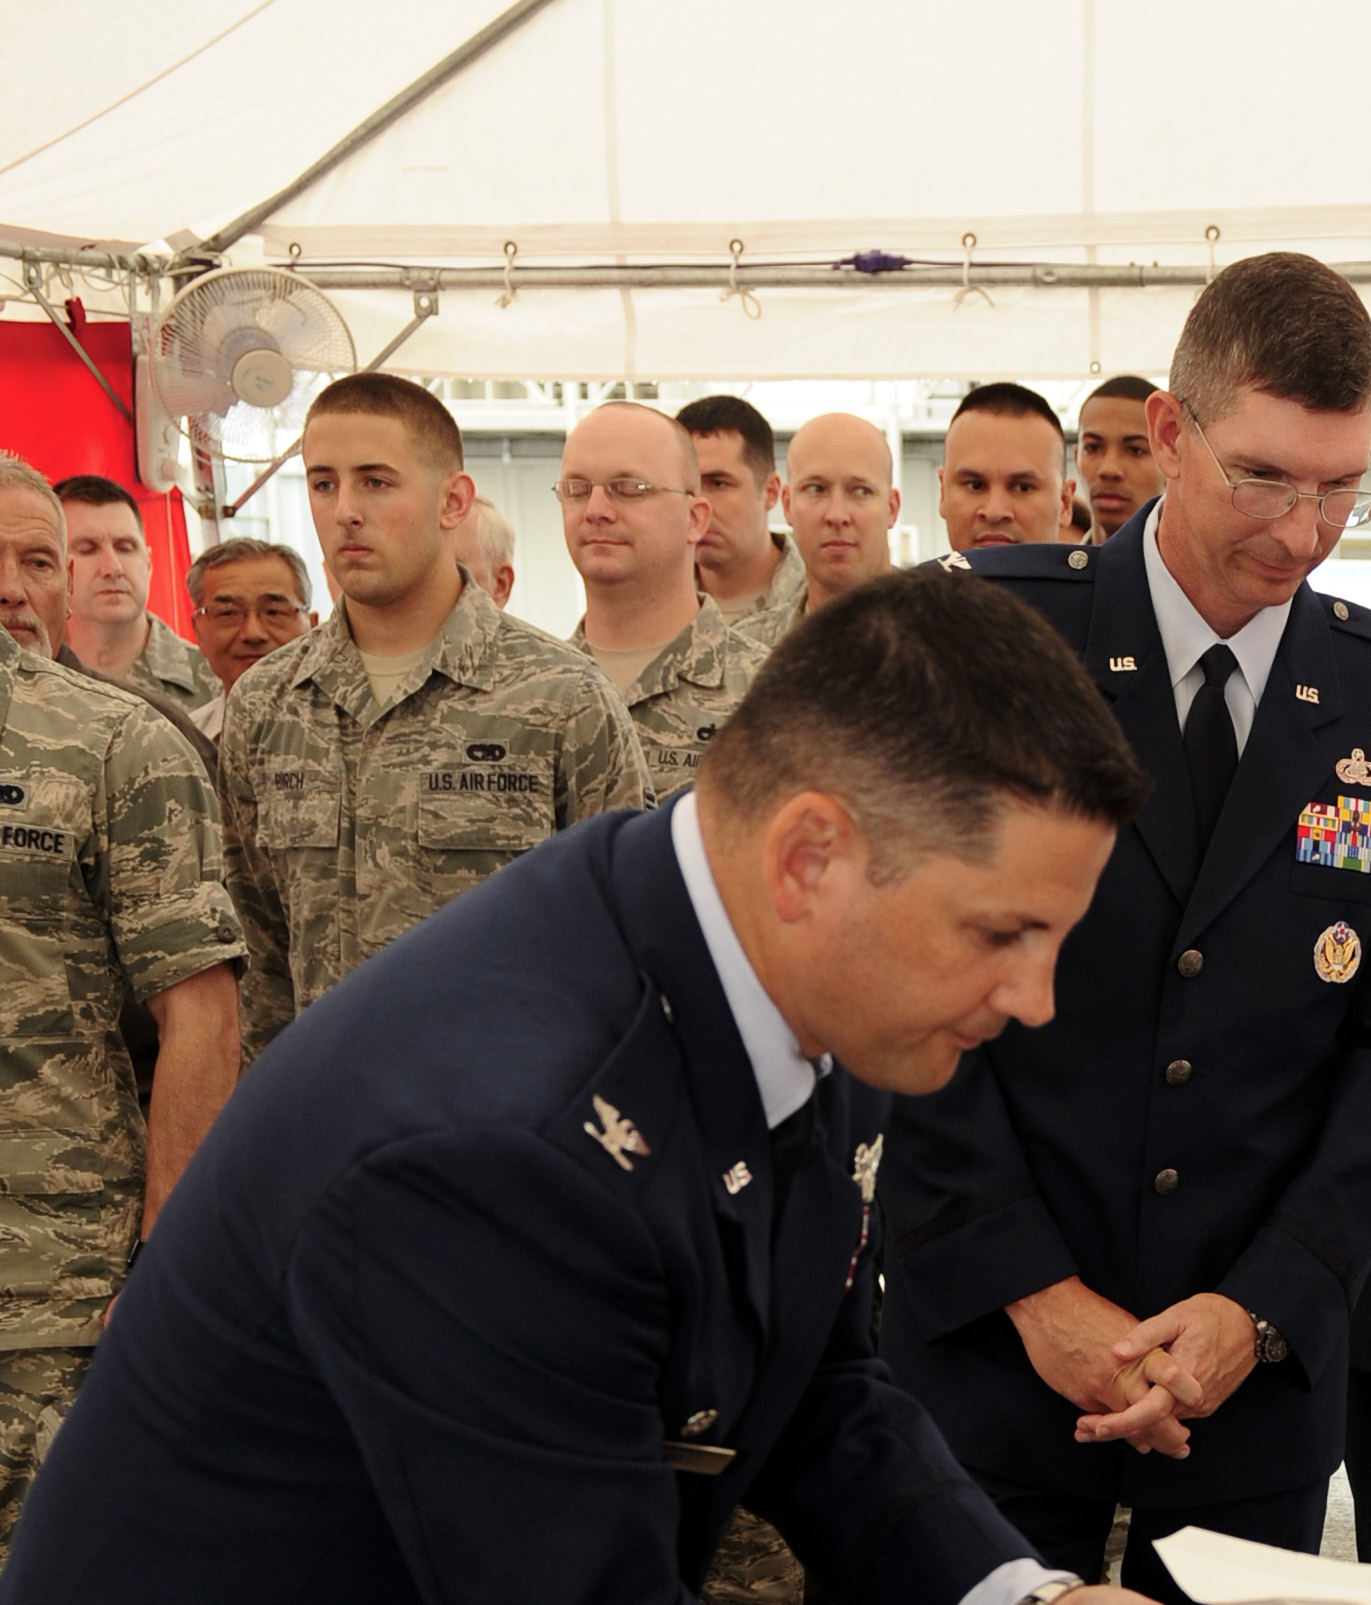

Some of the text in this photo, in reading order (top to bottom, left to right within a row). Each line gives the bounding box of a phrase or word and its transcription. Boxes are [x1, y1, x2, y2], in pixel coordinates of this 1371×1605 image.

[428, 772, 540, 793] U.S. AIR FORCE
[2, 825, 66, 854] FORCE
